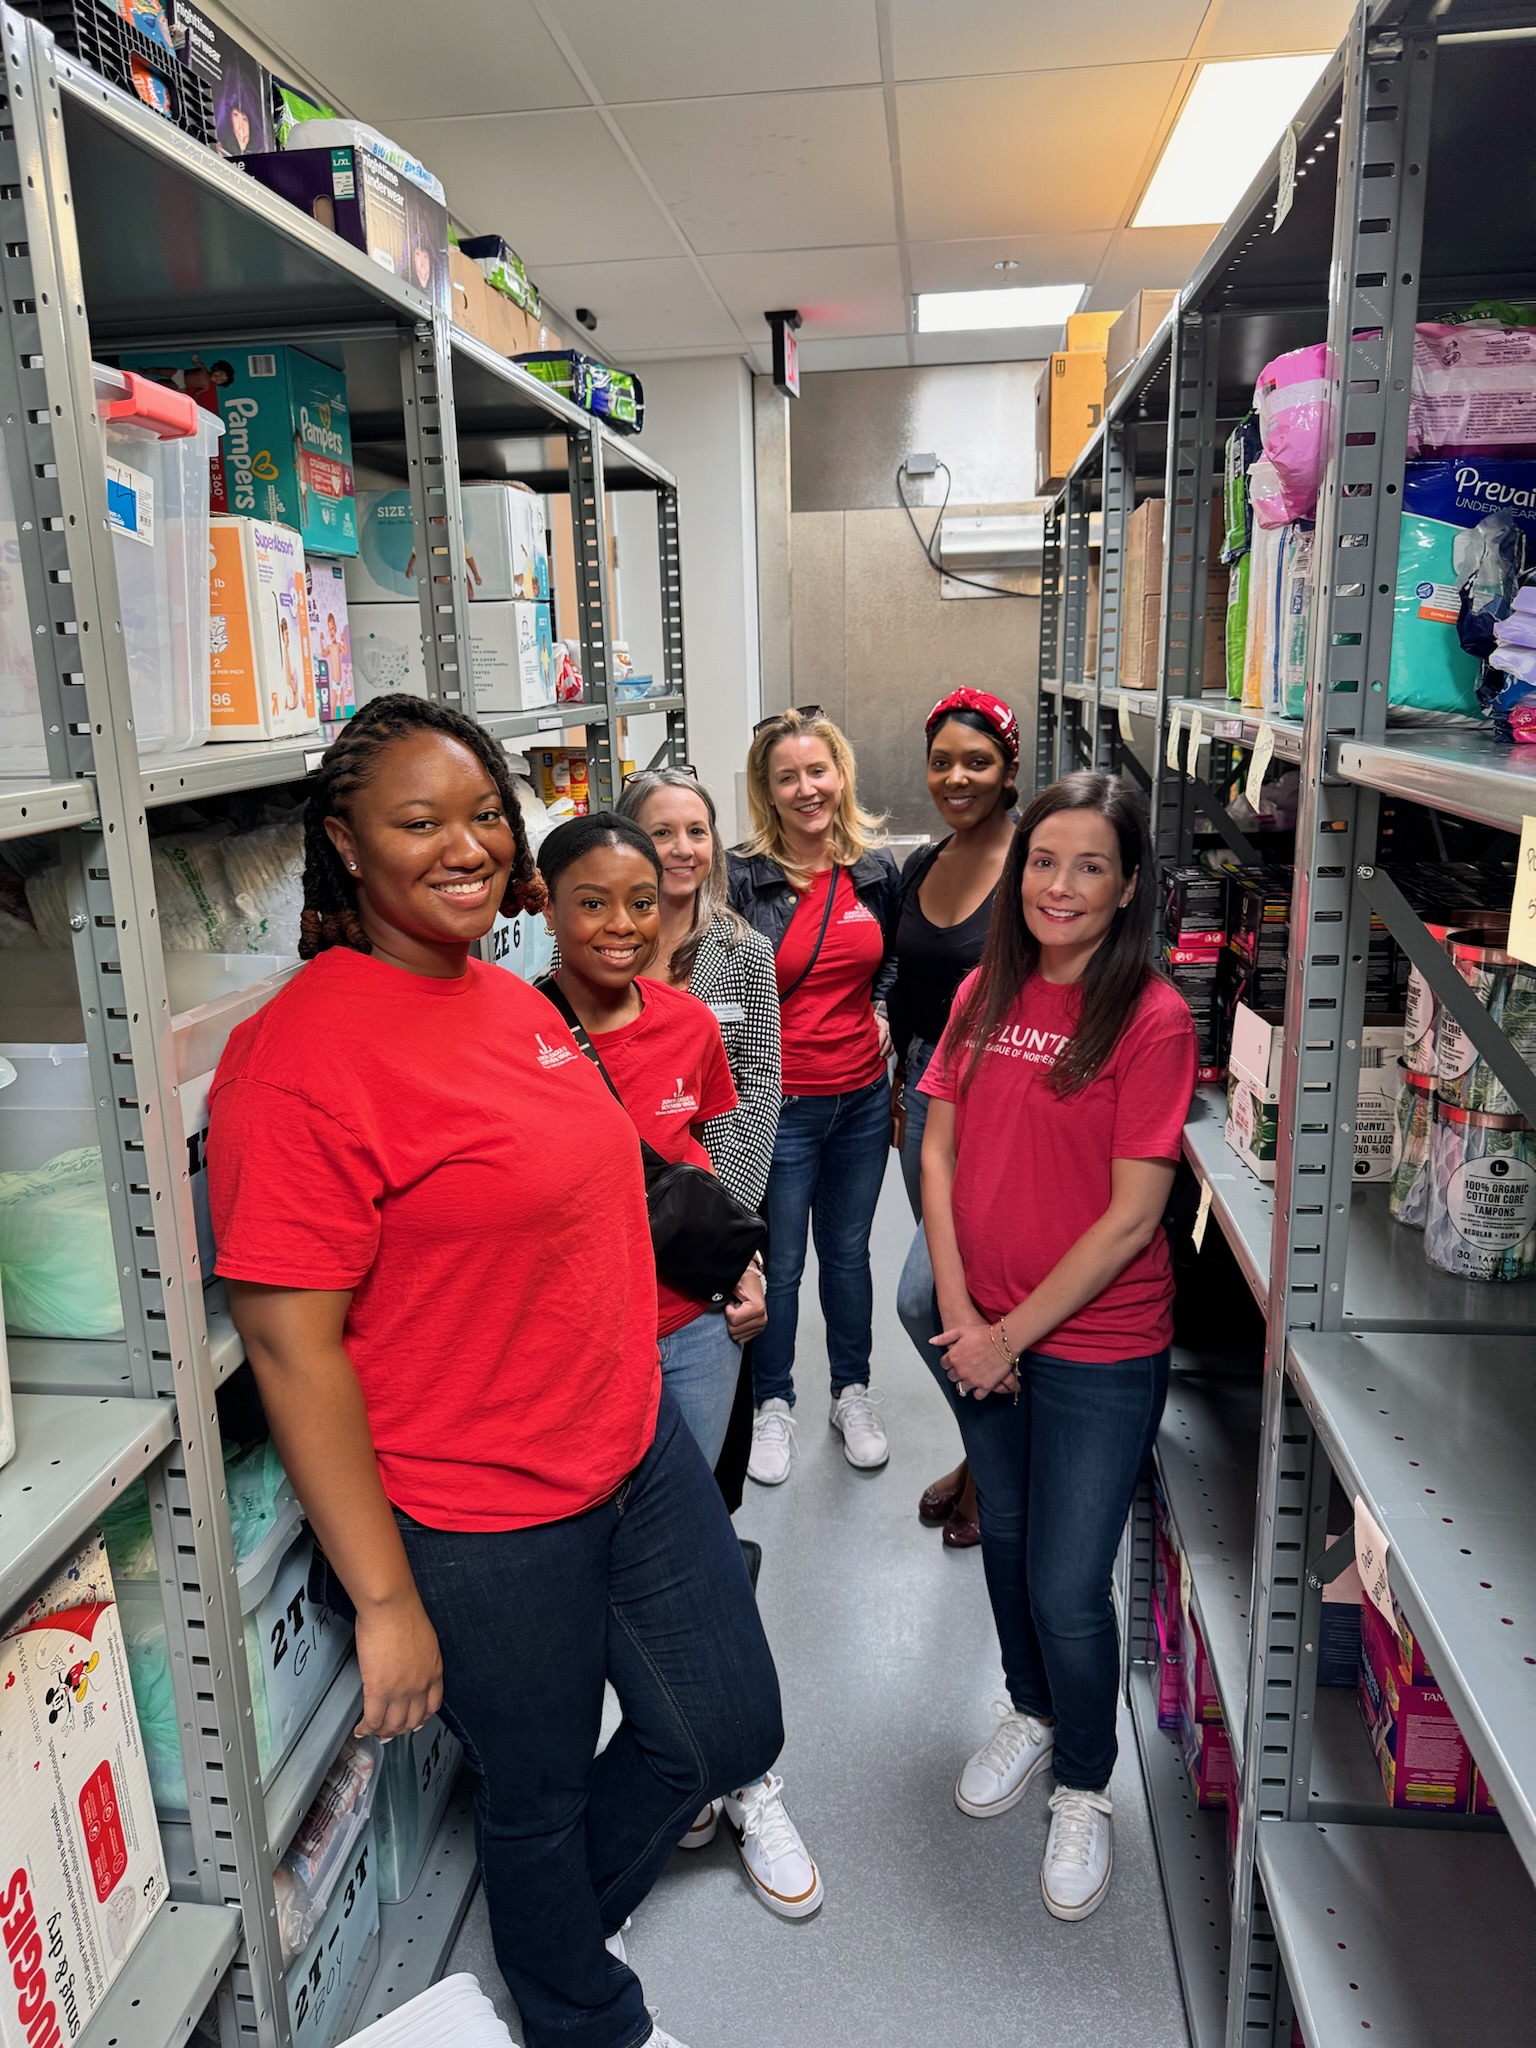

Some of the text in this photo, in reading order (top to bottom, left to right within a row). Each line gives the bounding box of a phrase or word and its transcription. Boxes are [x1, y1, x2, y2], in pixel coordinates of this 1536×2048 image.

[176, 1, 215, 42] nighttime
[177, 21, 221, 64] uerwear
[333, 158, 351, 166] L/XL
[363, 153, 399, 187] nighttime
[364, 172, 405, 206] underwear
[300, 406, 342, 455] Pampers
[225, 397, 259, 510] Pampers
[377, 506, 406, 518] SIZE
[214, 578, 225, 588] lb
[213, 658, 221, 668] 2
[212, 693, 231, 706] 96
[493, 920, 521, 961] ZE 6
[1011, 1048, 1022, 1058] OF
[1355, 1122, 1385, 1131] TAMPO
[1361, 1135, 1394, 1144] COTTON
[1372, 1145, 1391, 1154] 00%
[1465, 1180, 1530, 1194] 100% ORGANIC
[1466, 1191, 1525, 1204] COTTON CORE
[1474, 1205, 1515, 1217] TAMPONS
[1464, 1228, 1493, 1238] REGULAR
[1457, 1250, 1470, 1260] 30
[271, 1585, 306, 1670] 2T
[294, 1604, 336, 1676] GIR
[1422, 1692, 1448, 1703] TAM
[57, 1782, 70, 1824] quelques
[68, 1836, 80, 1874] absorbe
[62, 1863, 75, 1901] Absorbs
[74, 1872, 86, 1910] couches
[143, 1876, 155, 1897] 3
[70, 1900, 85, 1953] Protection
[83, 1908, 91, 1931] trois
[295, 1945, 323, 2032] 2T
[344, 1844, 369, 1919] 3T
[0, 1868, 64, 2048] UGGIES
[81, 1951, 90, 1980] Layer
[47, 1911, 81, 2039] snug & dry
[308, 1941, 344, 2026] BOY
[86, 1977, 96, 2009] Triple
